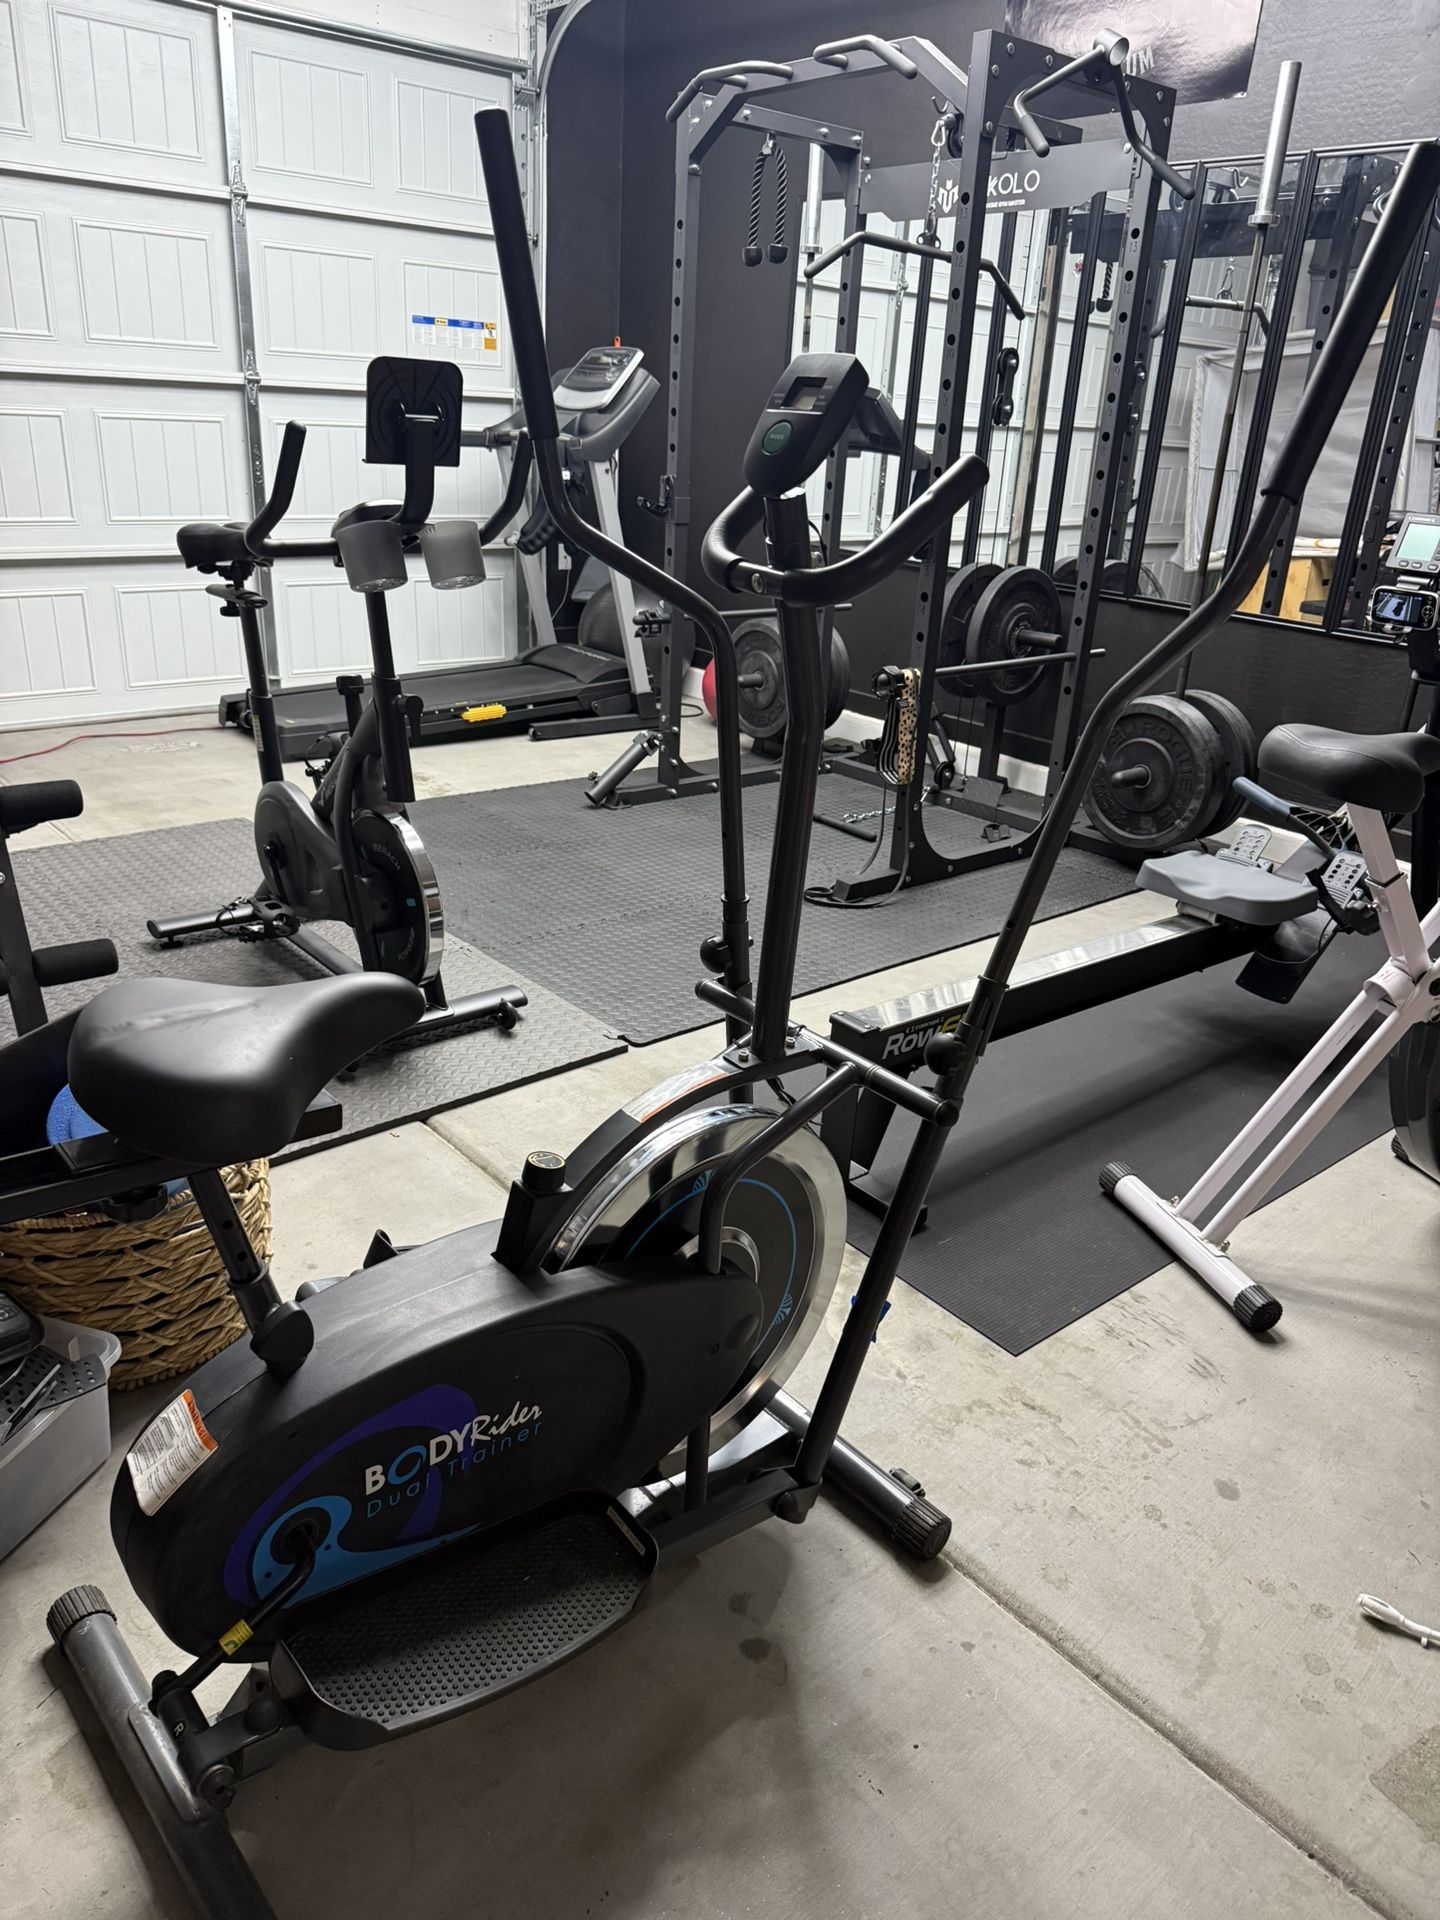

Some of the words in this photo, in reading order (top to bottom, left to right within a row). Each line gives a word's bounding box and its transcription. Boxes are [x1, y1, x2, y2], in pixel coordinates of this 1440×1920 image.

[987, 169, 1040, 197] KOLO
[367, 1473, 430, 1518] Dual
[447, 1421, 543, 1477] Trainer
